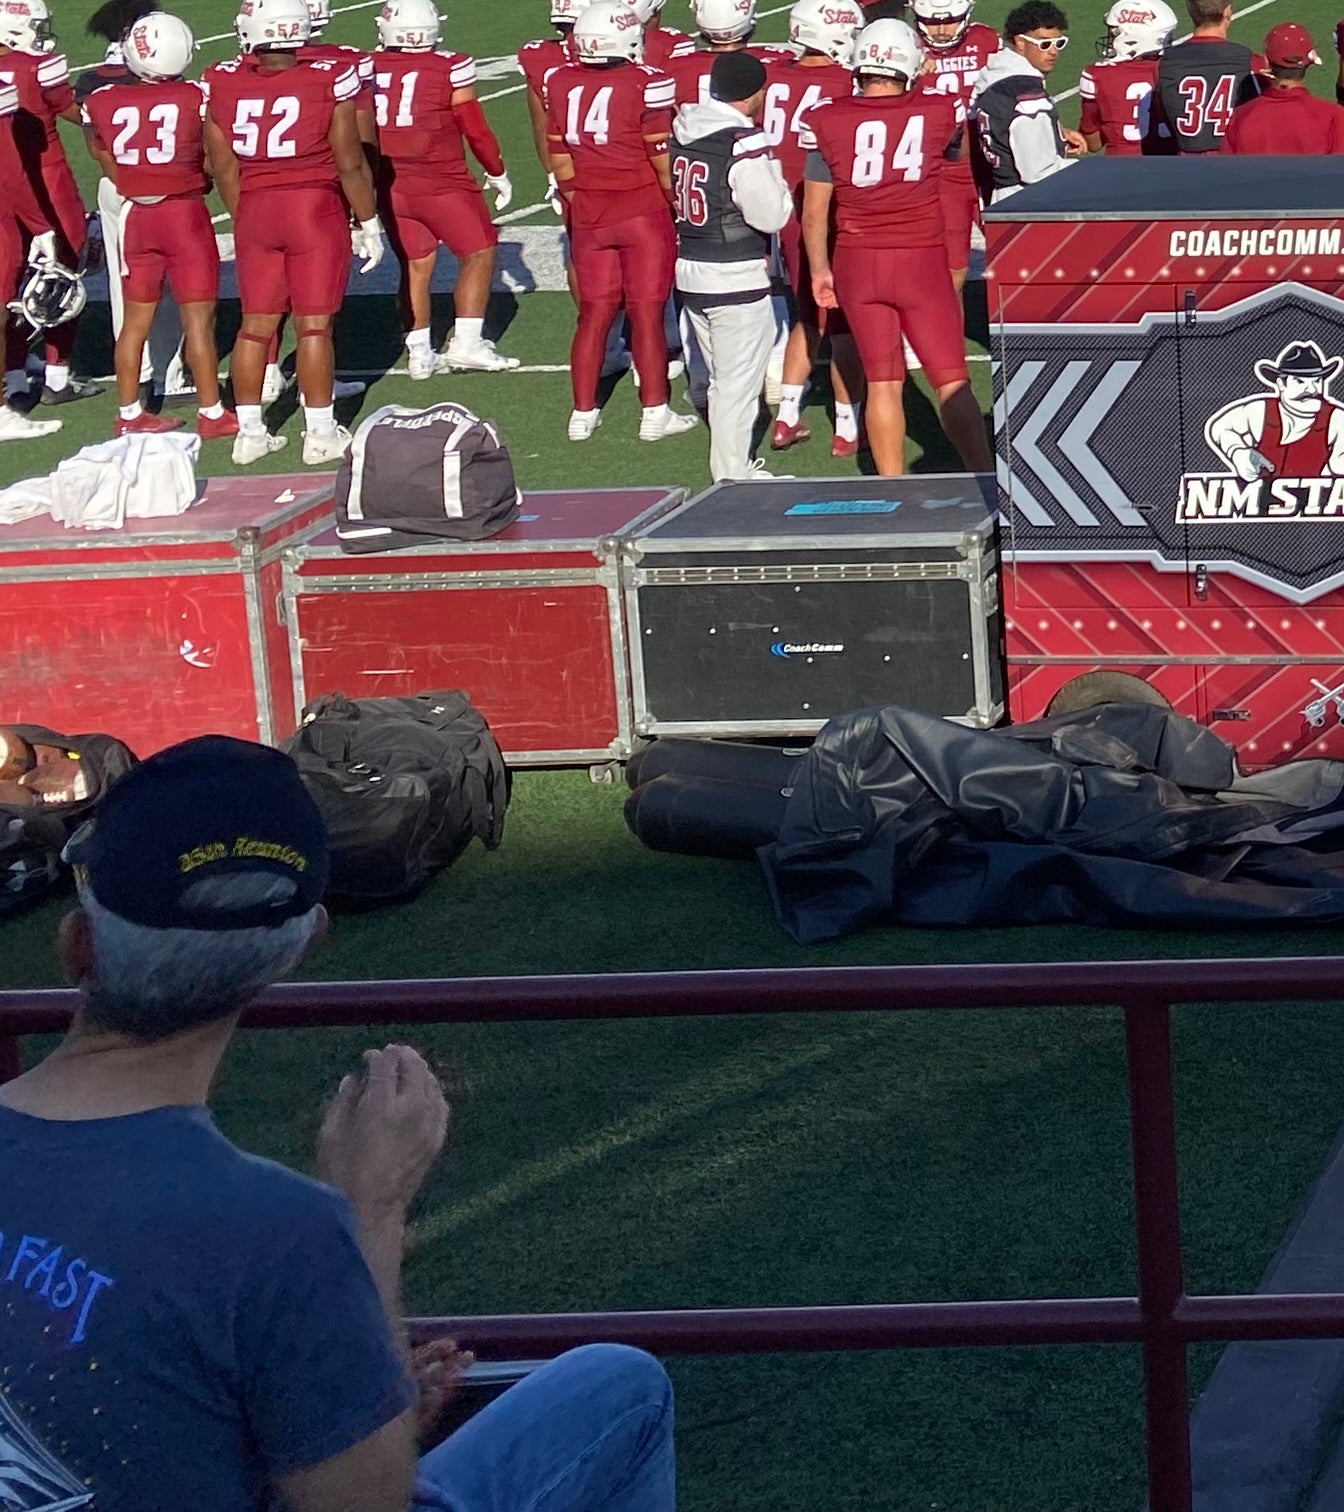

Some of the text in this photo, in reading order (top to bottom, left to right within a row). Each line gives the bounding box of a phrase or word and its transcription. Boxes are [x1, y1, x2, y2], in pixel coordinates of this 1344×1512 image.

[823, 7, 859, 26] State
[110, 102, 181, 167] 23
[231, 95, 302, 160] 52
[565, 85, 614, 146] 14
[763, 81, 822, 147] 64
[1175, 73, 1237, 138] 34
[851, 114, 925, 189] 84
[671, 155, 710, 228] 36
[1184, 478, 1264, 517] NM
[783, 643, 844, 653] CoachComm
[7, 1234, 114, 1346] FAST
